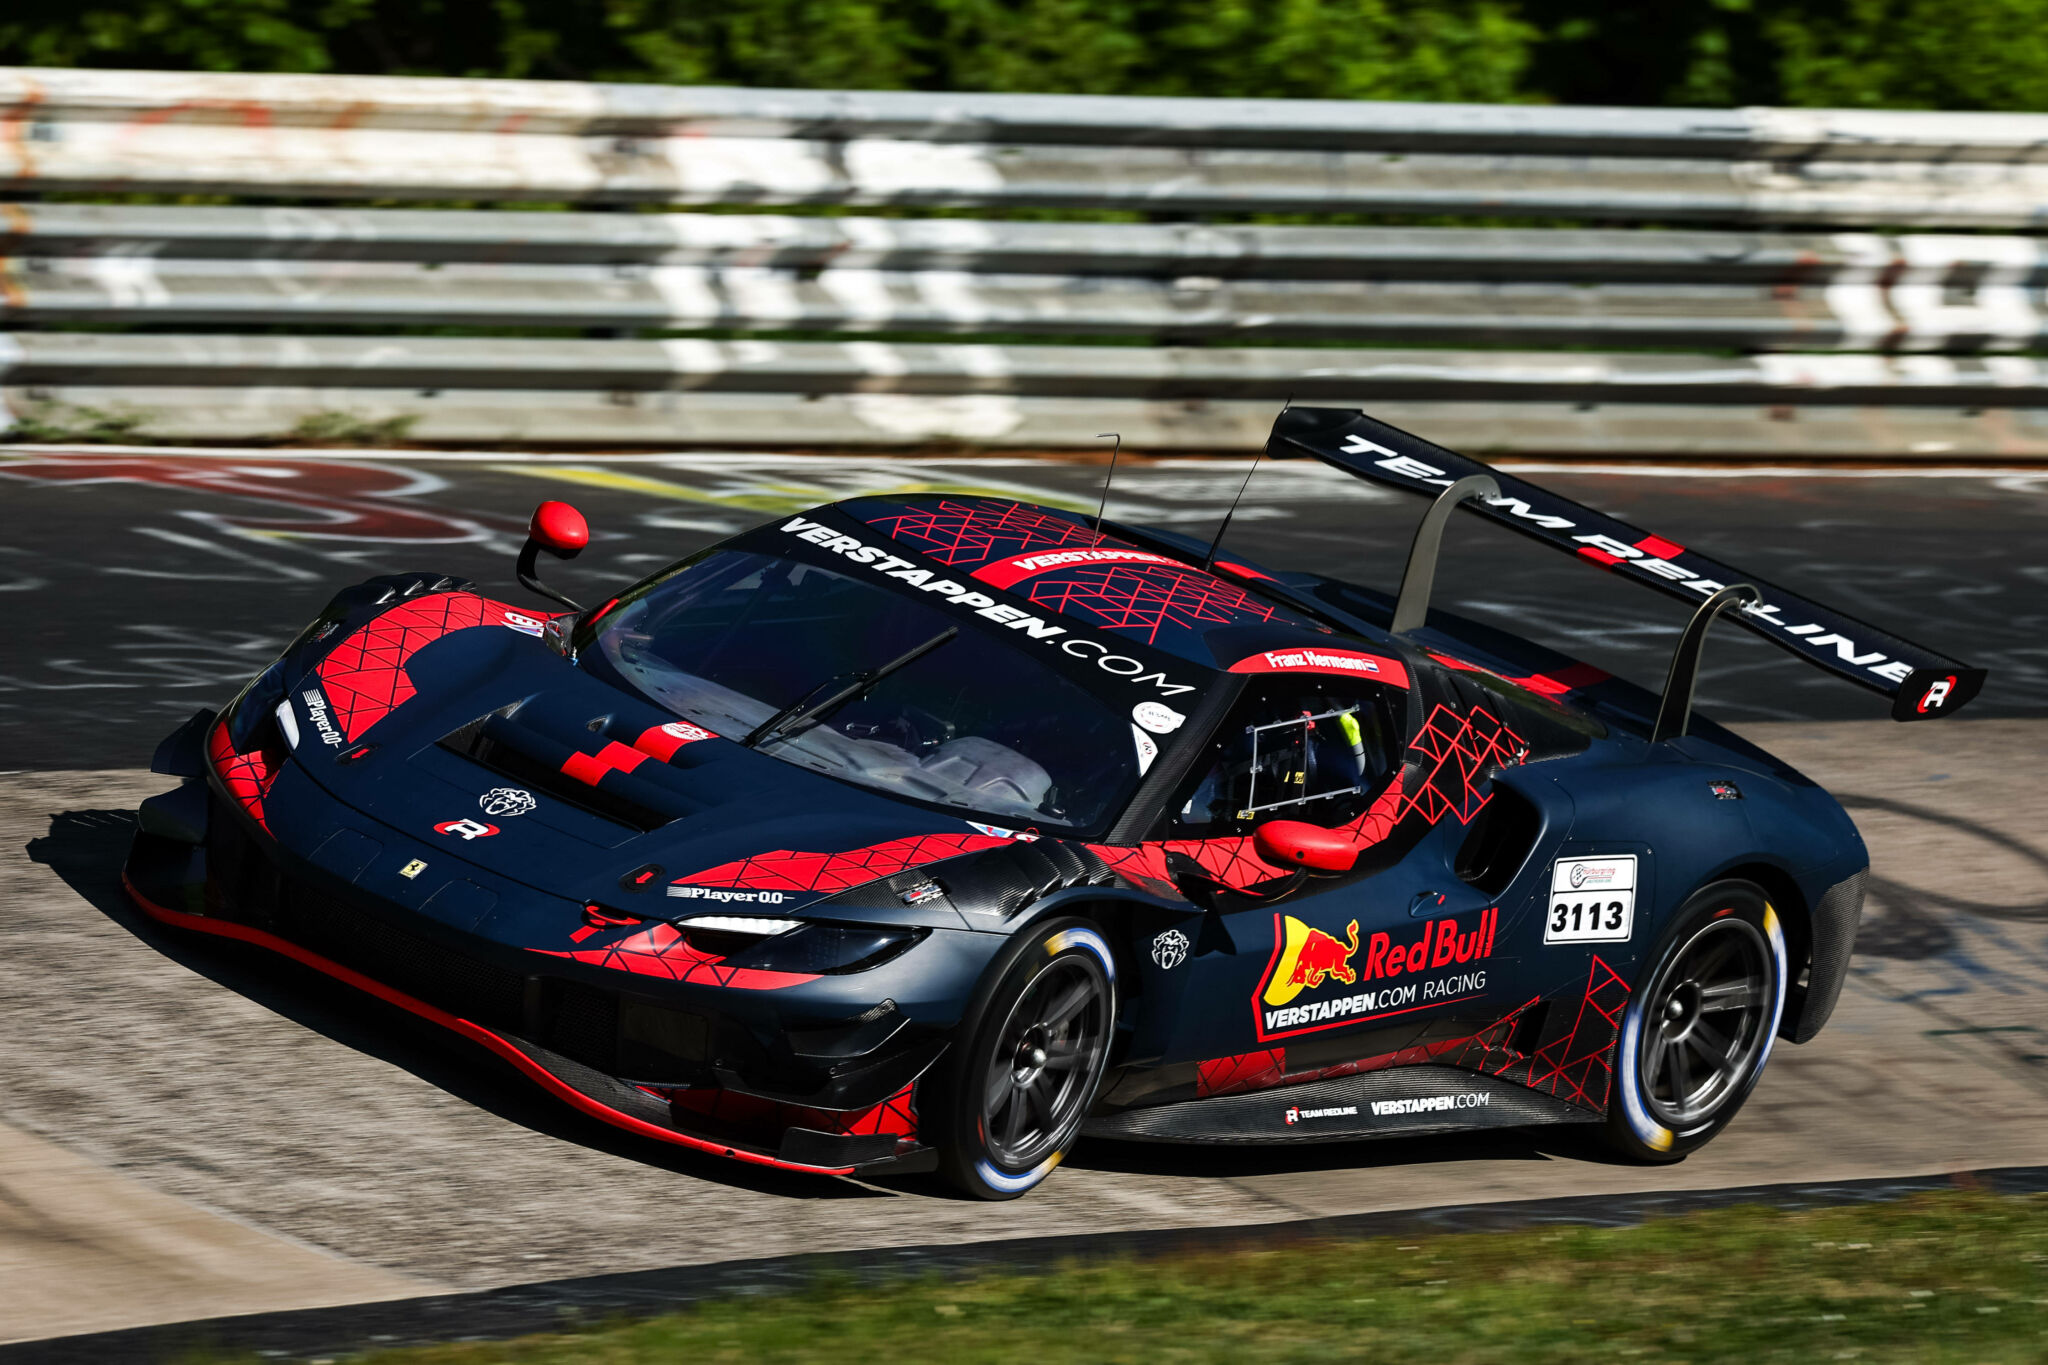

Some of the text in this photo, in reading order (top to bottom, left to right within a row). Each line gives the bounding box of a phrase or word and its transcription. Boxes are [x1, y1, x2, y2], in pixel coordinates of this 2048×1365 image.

[779, 516, 1196, 697] VERSTAPPEN.COM
[1264, 650, 1367, 671] Franz Hermann
[307, 698, 333, 732] Player
[689, 888, 758, 903] Player
[1551, 901, 1624, 933] 3113
[1362, 907, 1499, 982] Red Bull
[1265, 970, 1487, 1030] VERSTAPPEN.COM RACING
[1300, 1108, 1325, 1119] TEAM
[1324, 1106, 1358, 1117] REDLINE
[1371, 1092, 1491, 1116] VERSTAPPEN.COM
